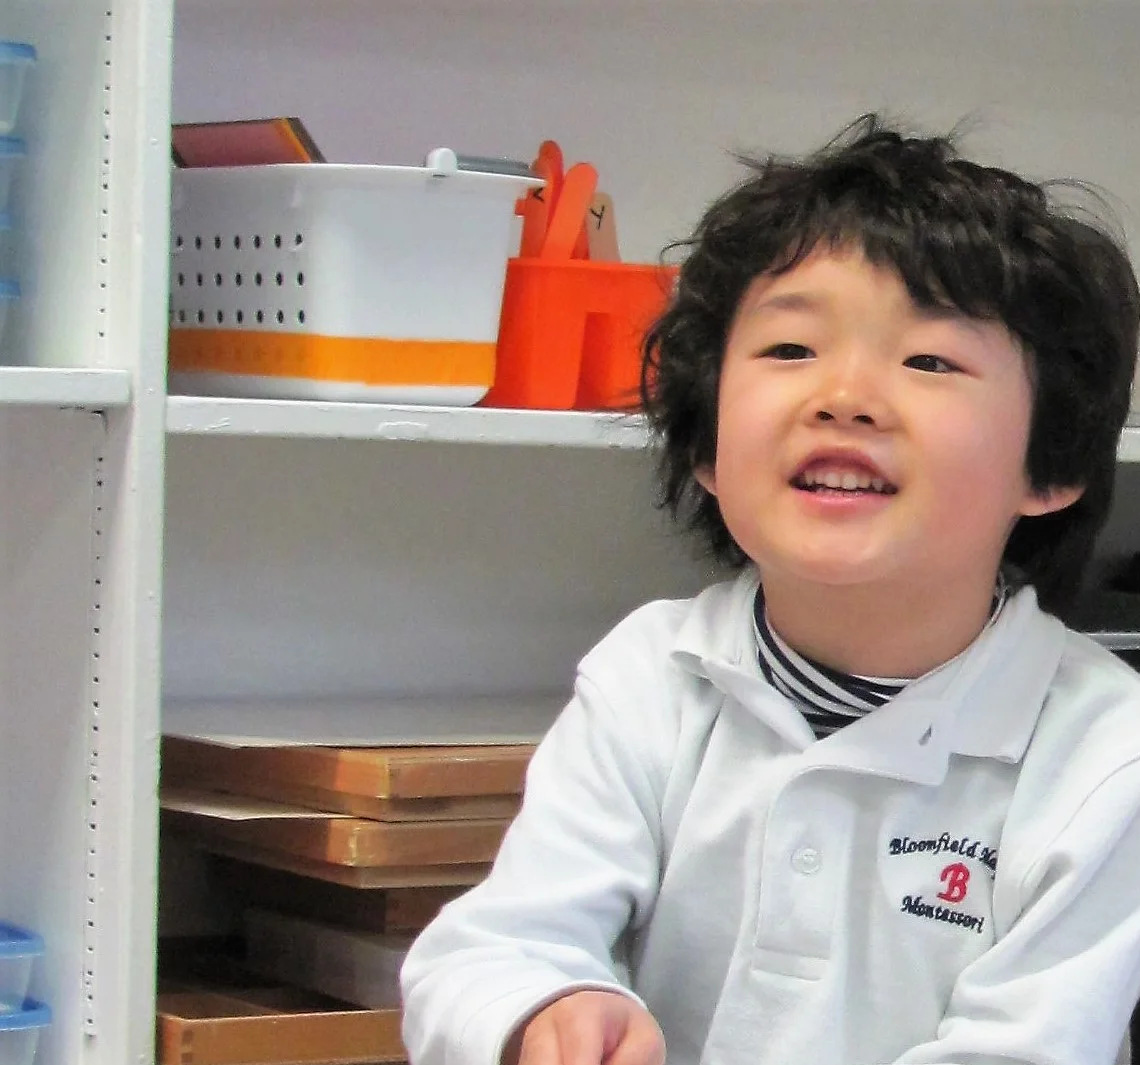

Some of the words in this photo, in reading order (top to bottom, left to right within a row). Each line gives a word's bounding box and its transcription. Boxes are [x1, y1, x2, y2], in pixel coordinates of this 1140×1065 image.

[889, 831, 981, 858] Bloomfield
[936, 861, 971, 904] B
[900, 895, 985, 934] Montessori
